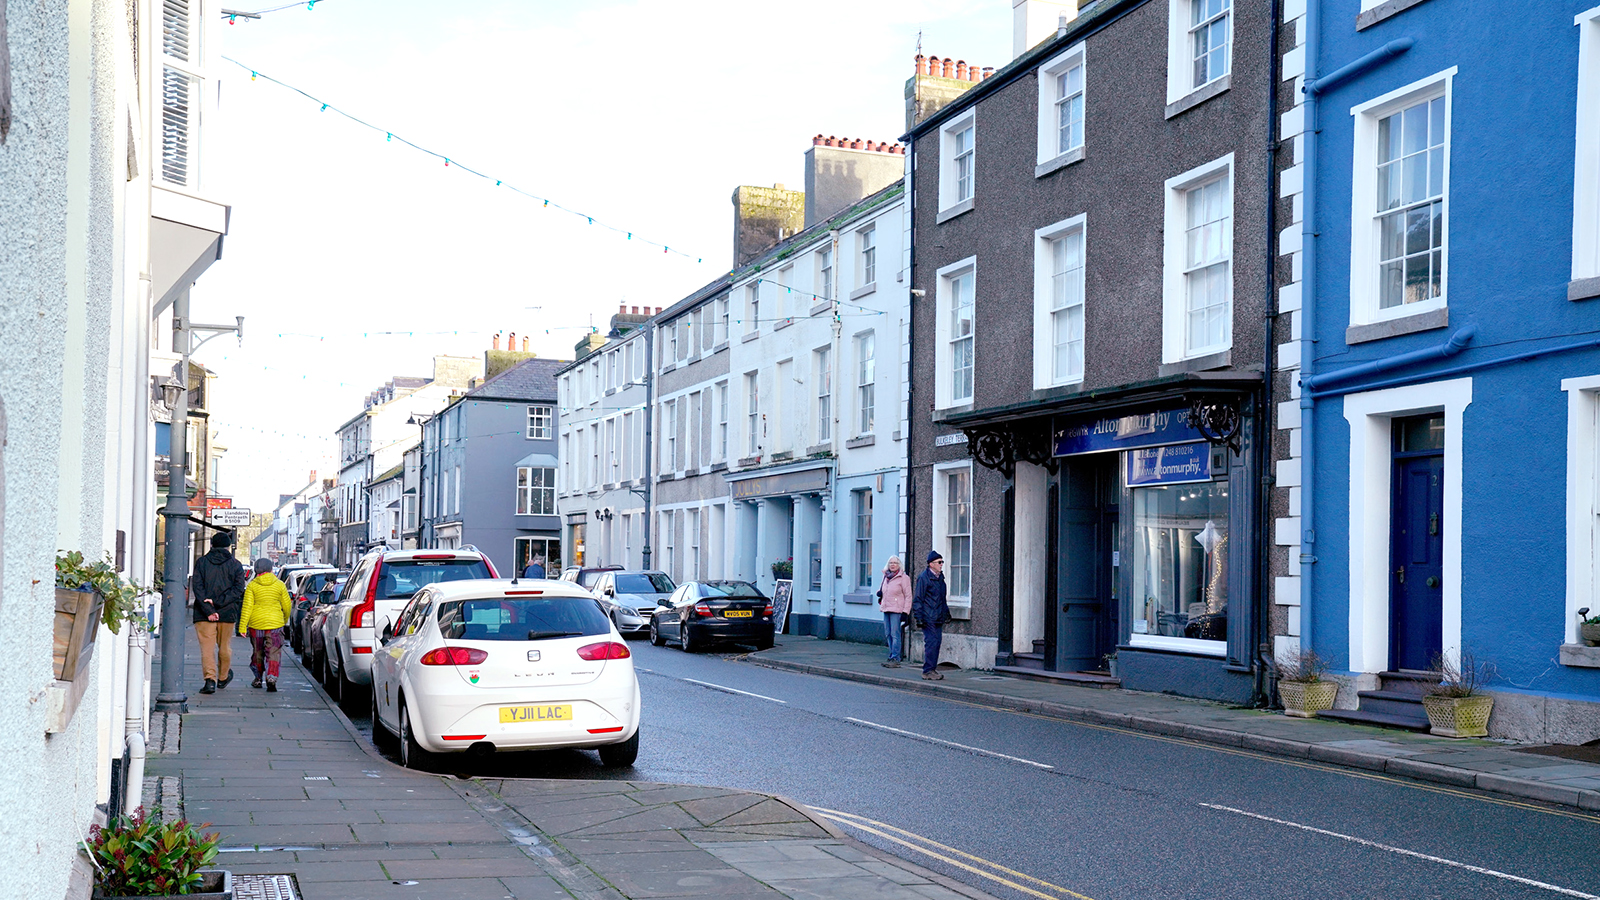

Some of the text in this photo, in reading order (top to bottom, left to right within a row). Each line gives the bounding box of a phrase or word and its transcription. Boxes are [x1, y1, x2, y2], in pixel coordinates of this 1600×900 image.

[1093, 418, 1121, 434] Alton
[1175, 446, 1194, 456] 810216
[1432, 474, 1438, 486] 2
[735, 479, 761, 497] JOLLYS
[510, 706, 562, 720] YJ11 LAC
